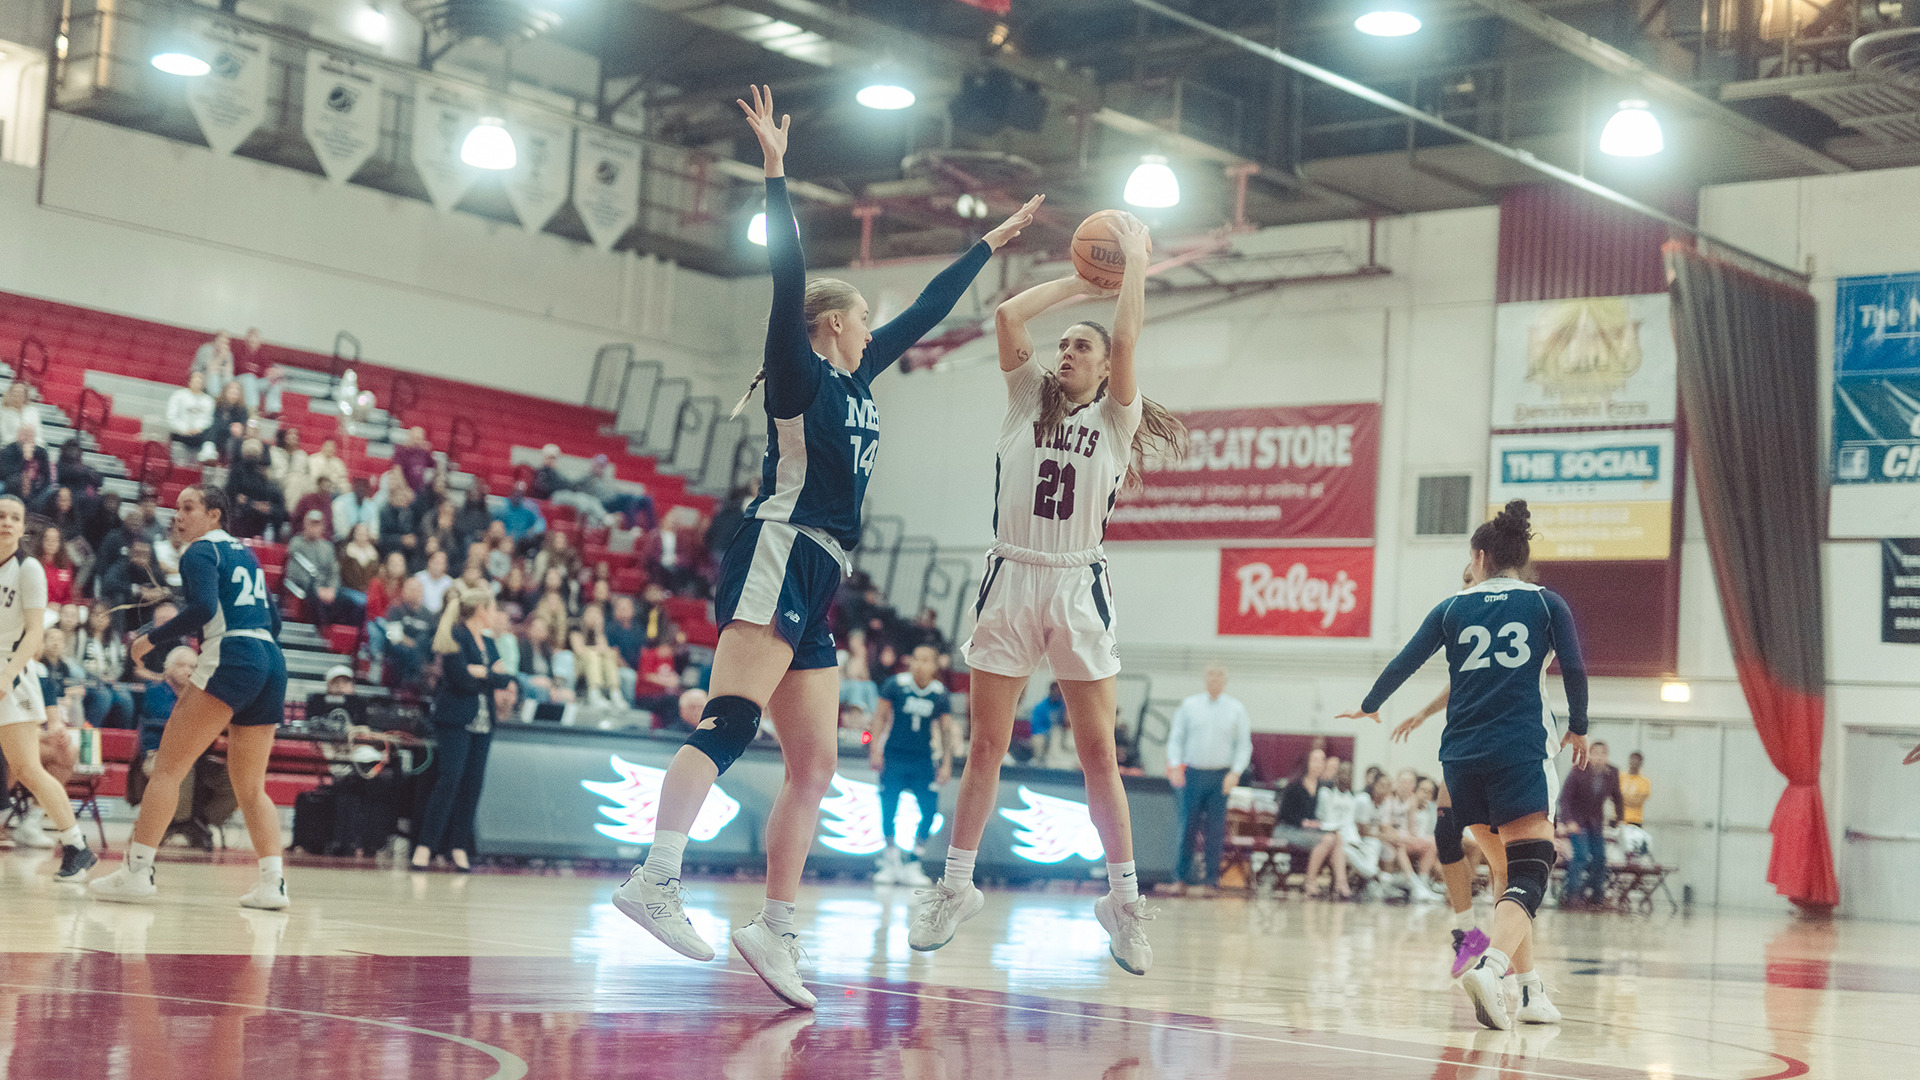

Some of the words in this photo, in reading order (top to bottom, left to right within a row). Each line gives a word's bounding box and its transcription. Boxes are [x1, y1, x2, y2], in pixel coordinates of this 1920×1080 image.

[850, 435, 878, 477] 14
[1255, 424, 1354, 469] STORE
[1506, 452, 1554, 479] THE
[1560, 450, 1654, 478] SOCIAL
[1033, 459, 1076, 520] 23
[231, 566, 269, 608] 24
[1238, 562, 1357, 629] Raley's
[1458, 621, 1531, 672] 23
